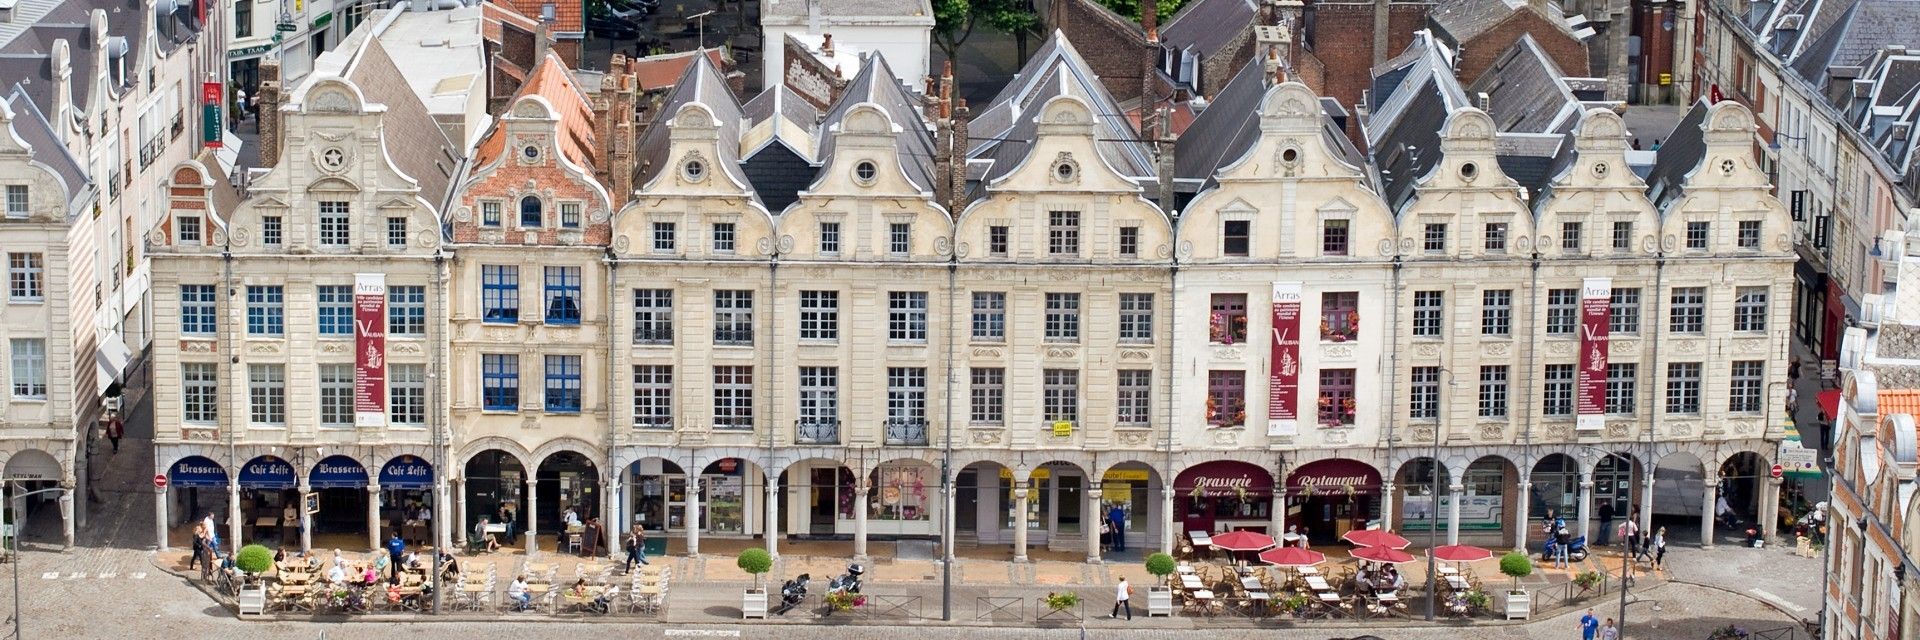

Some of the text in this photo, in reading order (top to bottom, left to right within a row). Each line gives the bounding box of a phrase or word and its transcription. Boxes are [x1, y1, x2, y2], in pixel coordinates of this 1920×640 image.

[358, 282, 384, 292] Arras
[1585, 287, 1610, 296] Arras
[1275, 290, 1300, 300] Arras
[180, 463, 223, 474] Brasserie
[250, 464, 289, 476] Café Leffe
[320, 463, 364, 474] Brasserie
[388, 465, 428, 476] Café Leffe
[1194, 474, 1252, 488] Brasserie
[1298, 474, 1368, 486] Restaurant
